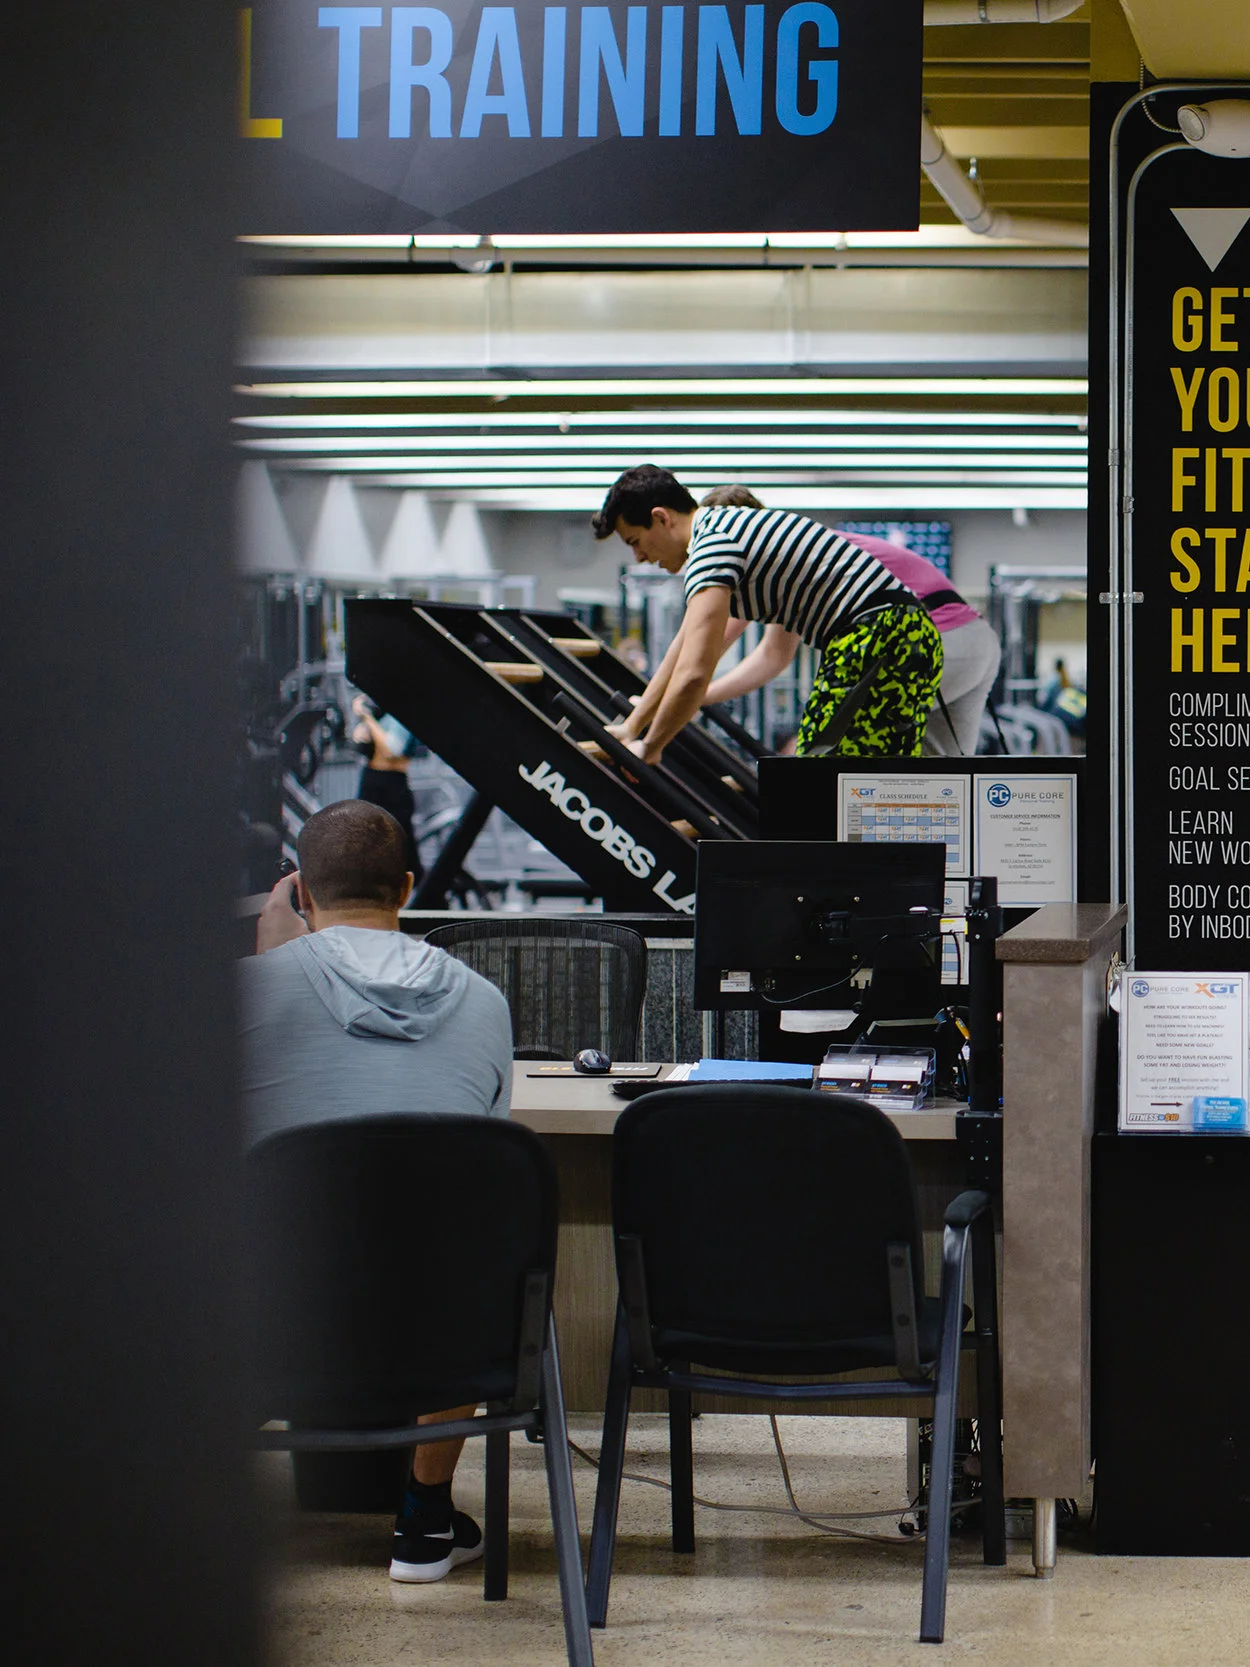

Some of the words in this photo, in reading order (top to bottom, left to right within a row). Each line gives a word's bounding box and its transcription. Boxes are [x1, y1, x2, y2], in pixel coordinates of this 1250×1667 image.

[317, 1, 840, 139] TRAINING
[1169, 722, 1250, 748] SESSION
[1169, 765, 1221, 791] GOAL
[989, 789, 1009, 801] PC
[1011, 792, 1036, 800] PURE
[1039, 792, 1064, 800] CORE
[518, 760, 656, 879] JACOBS
[1169, 810, 1233, 835] LEARN
[1169, 840, 1214, 865] NEW
[1169, 884, 1221, 909] BODY
[1169, 914, 1195, 939] BY
[1132, 984, 1148, 995] PC
[1193, 982, 1240, 998] XGT
[1129, 1113, 1159, 1122] FITNESS
